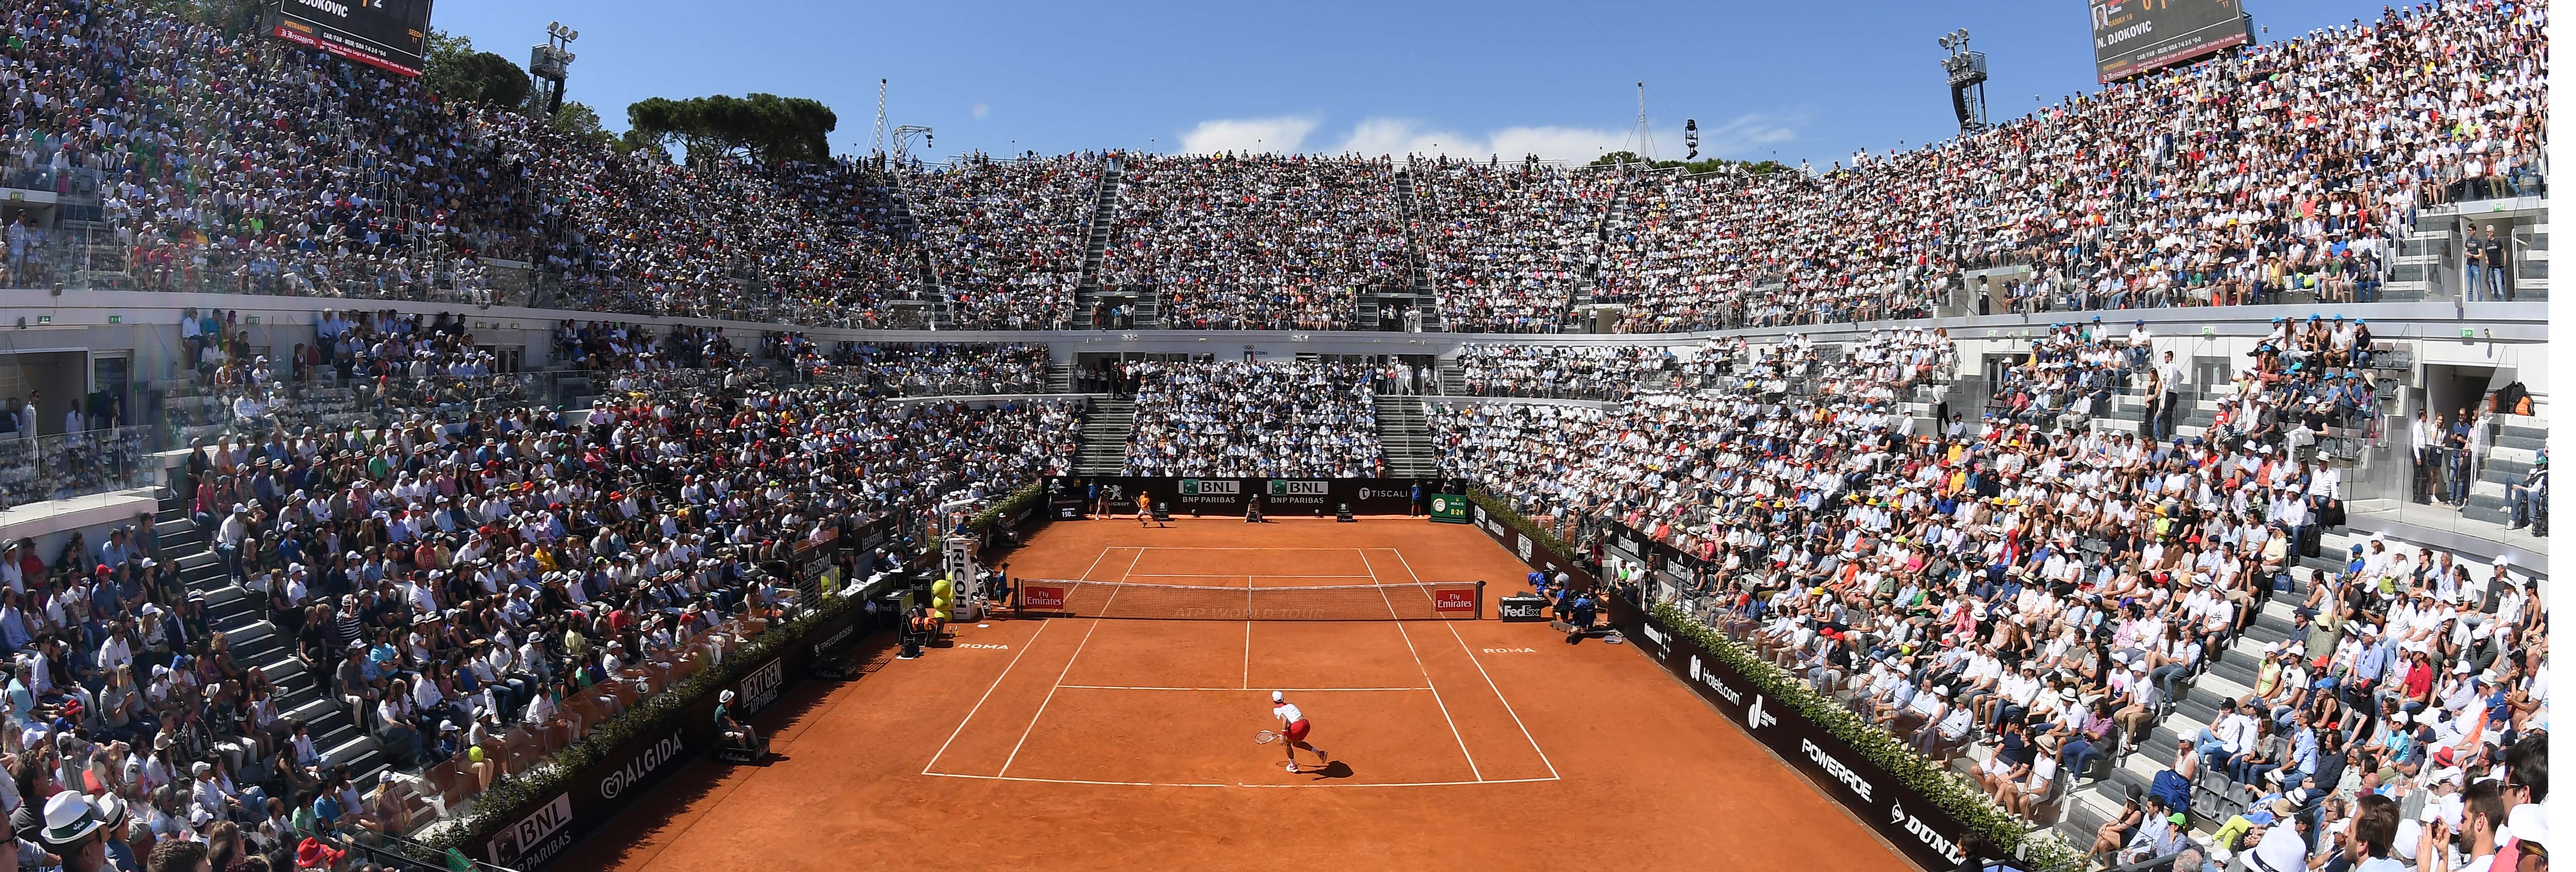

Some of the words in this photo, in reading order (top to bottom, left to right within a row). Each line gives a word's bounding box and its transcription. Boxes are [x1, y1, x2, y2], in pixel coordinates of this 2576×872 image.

[299, 0, 348, 18] OKOVIC
[284, 20, 313, 34] PIETRANGELI
[2097, 37, 2107, 49] N.
[2107, 20, 2152, 45] DJOKOVIC
[2103, 60, 2127, 72] PIETRANGELI
[1201, 482, 1236, 493] BNL
[1290, 482, 1324, 493] BNL
[1618, 533, 1639, 557] LEVISSIMA
[953, 549, 967, 609] RICOH
[1027, 596, 1061, 606] Emirates
[1437, 600, 1472, 608] Emirates
[1504, 605, 1540, 617] FedEx
[742, 671, 763, 704] NEXT
[764, 661, 781, 689] GEN
[750, 697, 760, 715] ATP
[760, 685, 778, 707] FINALS
[1761, 709, 1777, 726] danesi
[625, 731, 683, 787] ALGIDA
[520, 803, 567, 848] BNL
[526, 830, 571, 871] PARIBAS
[1904, 815, 1959, 865] DUNL
